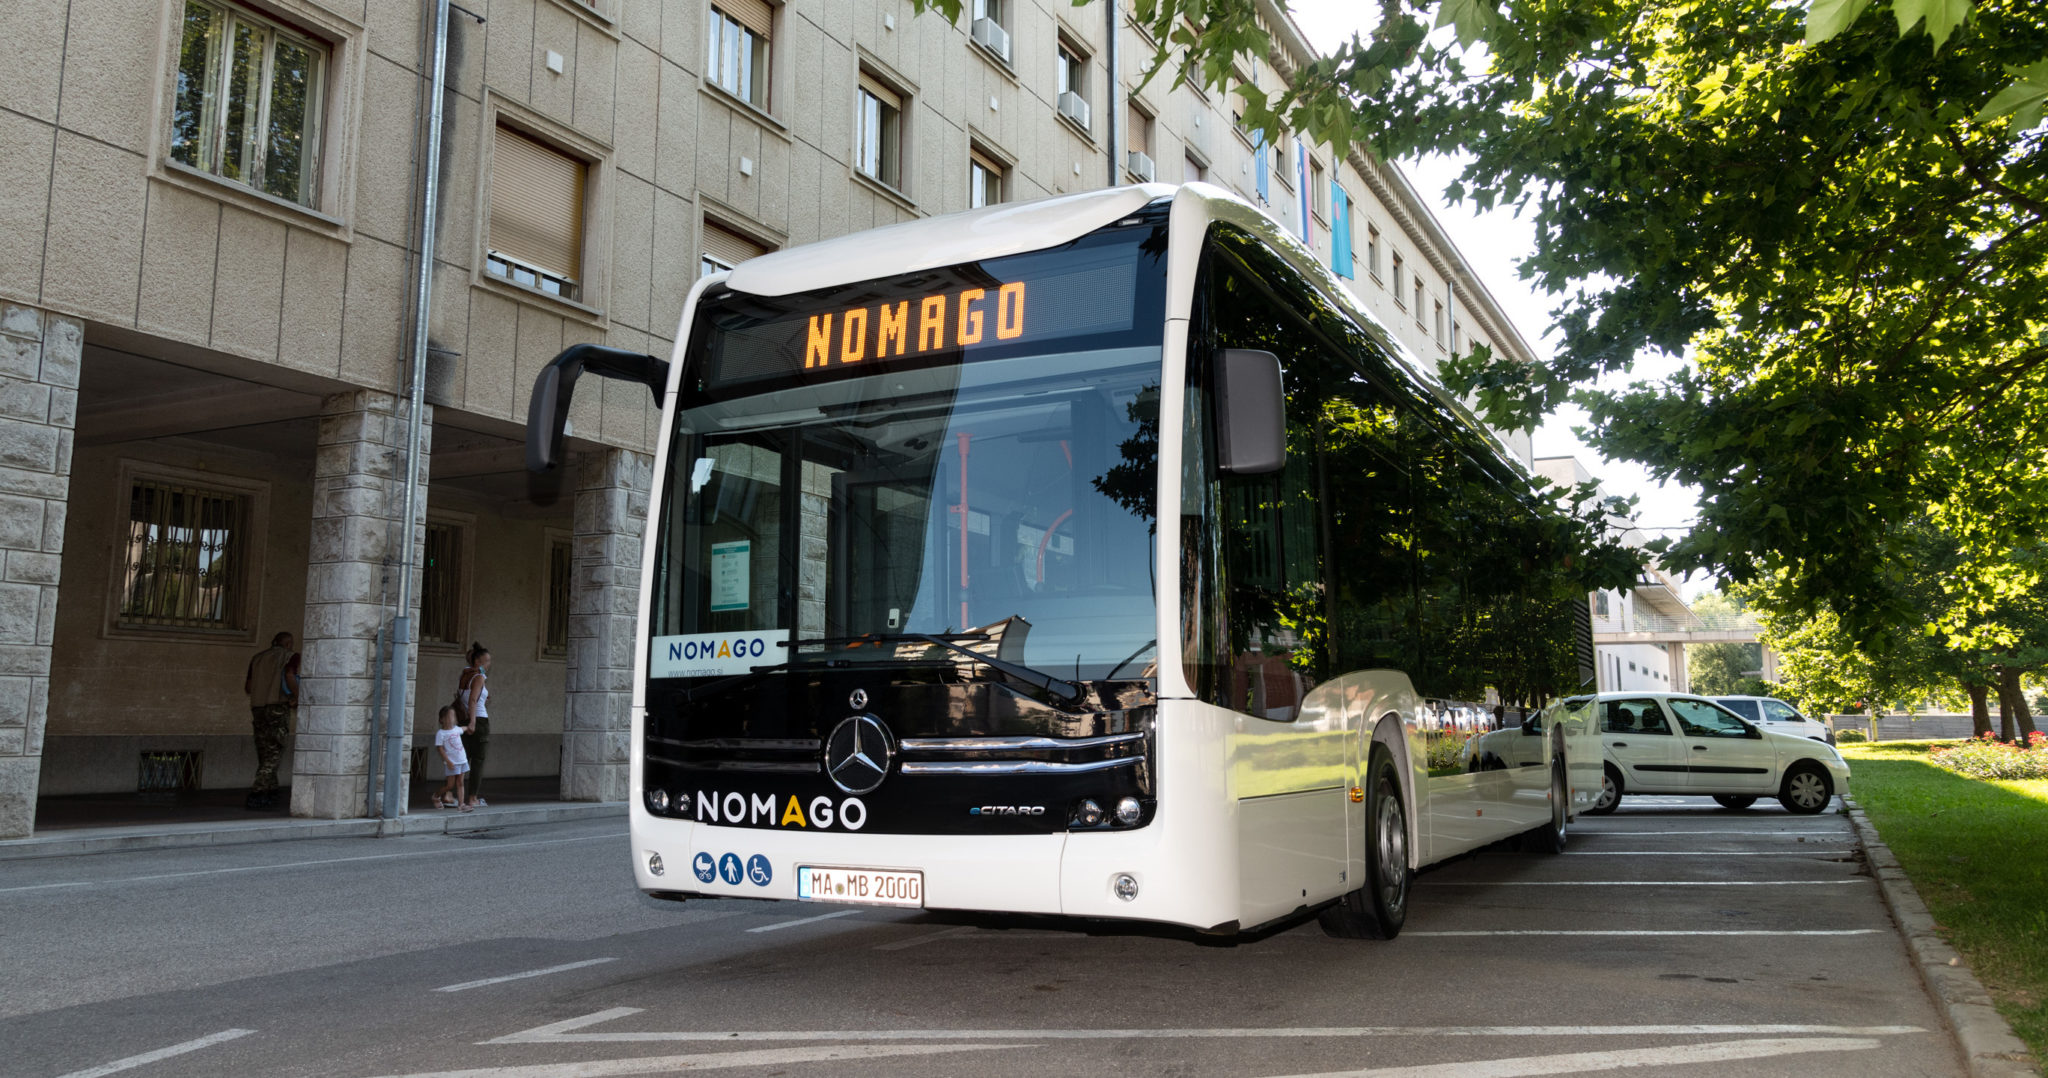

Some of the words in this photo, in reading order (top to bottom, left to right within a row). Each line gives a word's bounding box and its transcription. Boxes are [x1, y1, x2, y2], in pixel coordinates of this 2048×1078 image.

[805, 281, 1025, 369] NOMAGO
[668, 637, 765, 661] NOMAGO
[696, 790, 867, 831] NOMAGO
[969, 805, 1045, 816] eCITARO
[811, 872, 833, 895] MA
[847, 874, 869, 897] MB
[874, 876, 919, 900] 2000
